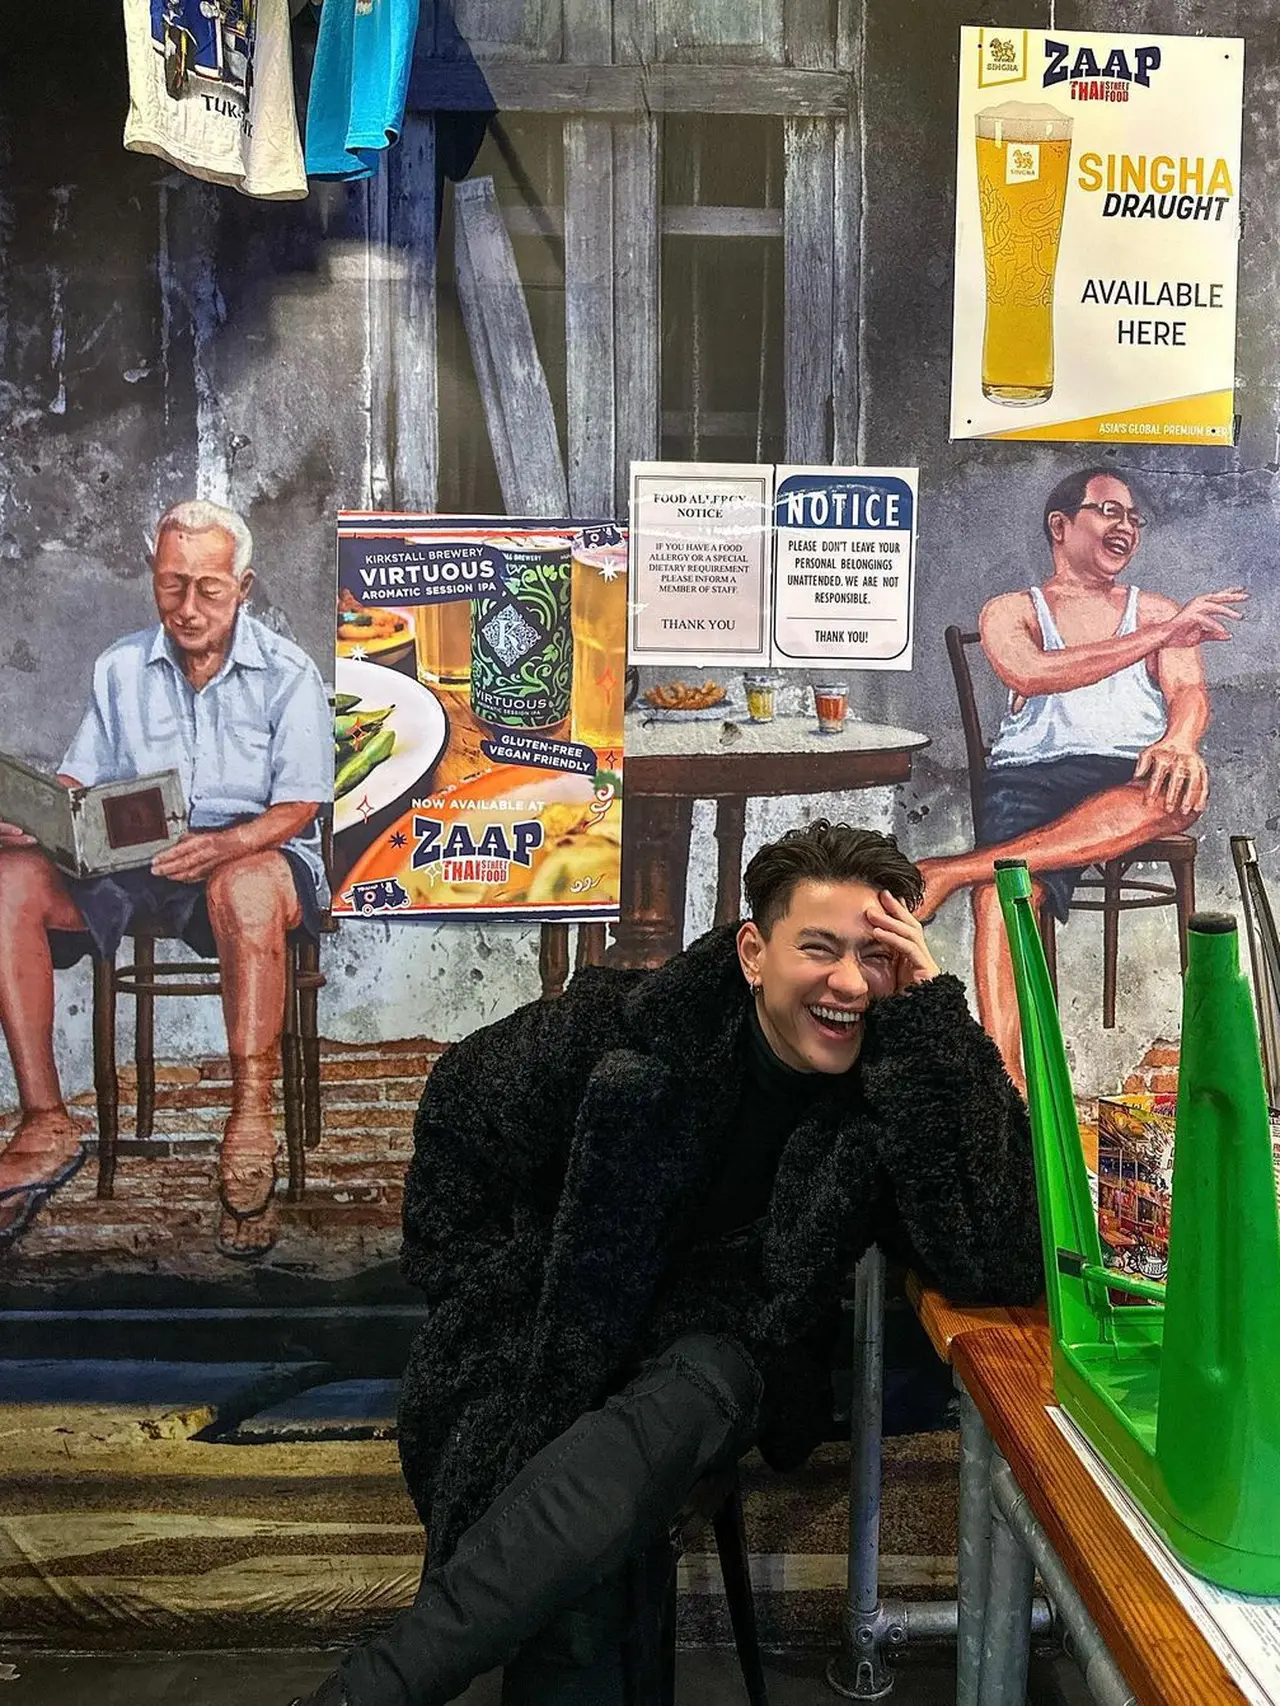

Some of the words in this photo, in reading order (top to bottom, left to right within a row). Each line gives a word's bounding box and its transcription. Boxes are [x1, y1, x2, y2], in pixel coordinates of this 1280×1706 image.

[1043, 39, 1161, 88] ZAAP
[1070, 81, 1104, 101] THAI
[1105, 91, 1129, 102] FOOD
[1078, 153, 1234, 196] SINGHA
[1102, 193, 1230, 221] DRAUGHT
[1081, 279, 1224, 308] AVAILABLE
[1117, 320, 1187, 346] HERE
[1099, 423, 1127, 435] ASIA'S
[1128, 423, 1161, 435] GLOBAL
[1163, 424, 1204, 436] PREMIUM
[654, 493, 687, 504] FOOD
[677, 508, 723, 518] NOTICE
[787, 491, 900, 527] NOTICE
[665, 542, 684, 551] YOU
[686, 543, 710, 552] HAVE
[711, 544, 717, 552] A
[719, 544, 743, 553] FOOD
[788, 540, 817, 552] PLEASE
[822, 541, 848, 553] DON'T
[851, 541, 875, 553] LEAVE
[879, 542, 901, 553] YOUR
[365, 551, 425, 565] KIRKSTALL
[428, 547, 484, 561] BREWERY
[649, 553, 690, 562] ALLERGY
[691, 554, 704, 562] OR
[705, 554, 712, 562] A
[712, 554, 748, 564] SPECIAL
[649, 563, 686, 572] DIETARY
[687, 564, 750, 574] REQUIREMENT
[795, 557, 837, 569] PERSONAL
[841, 558, 893, 571] BELONGINGS
[359, 560, 495, 587] VIRTUOUS
[661, 574, 693, 583] PLEASE
[695, 575, 729, 584] INFORM
[729, 575, 737, 584] A
[787, 574, 844, 587] UNATTENDED.
[845, 576, 859, 587] WE
[862, 576, 878, 588] ARE
[882, 576, 899, 588] NOT
[362, 587, 421, 600] AROMATIC
[426, 584, 473, 596] SESSION
[478, 582, 497, 592] IPA
[659, 585, 697, 593] MEMBER
[698, 585, 711, 593] OF
[814, 592, 871, 604] RESPONSIBLE.
[661, 618, 705, 630] THANK
[707, 619, 736, 630] YOU
[815, 630, 845, 642] THANK
[847, 631, 869, 643] YOU!
[476, 688, 547, 709] VIRTUOUS
[501, 734, 583, 758] GLUTEN-FREE
[489, 744, 531, 761] VEGAN
[533, 753, 591, 772] FRIENDLY
[411, 798, 445, 809] NOW
[449, 799, 525, 810] AVAILABLE
[528, 801, 545, 811] AT
[412, 816, 543, 869] ZAAP
[442, 860, 481, 881] THAI
[481, 860, 509, 869] STREET
[481, 871, 507, 882] FOOD
